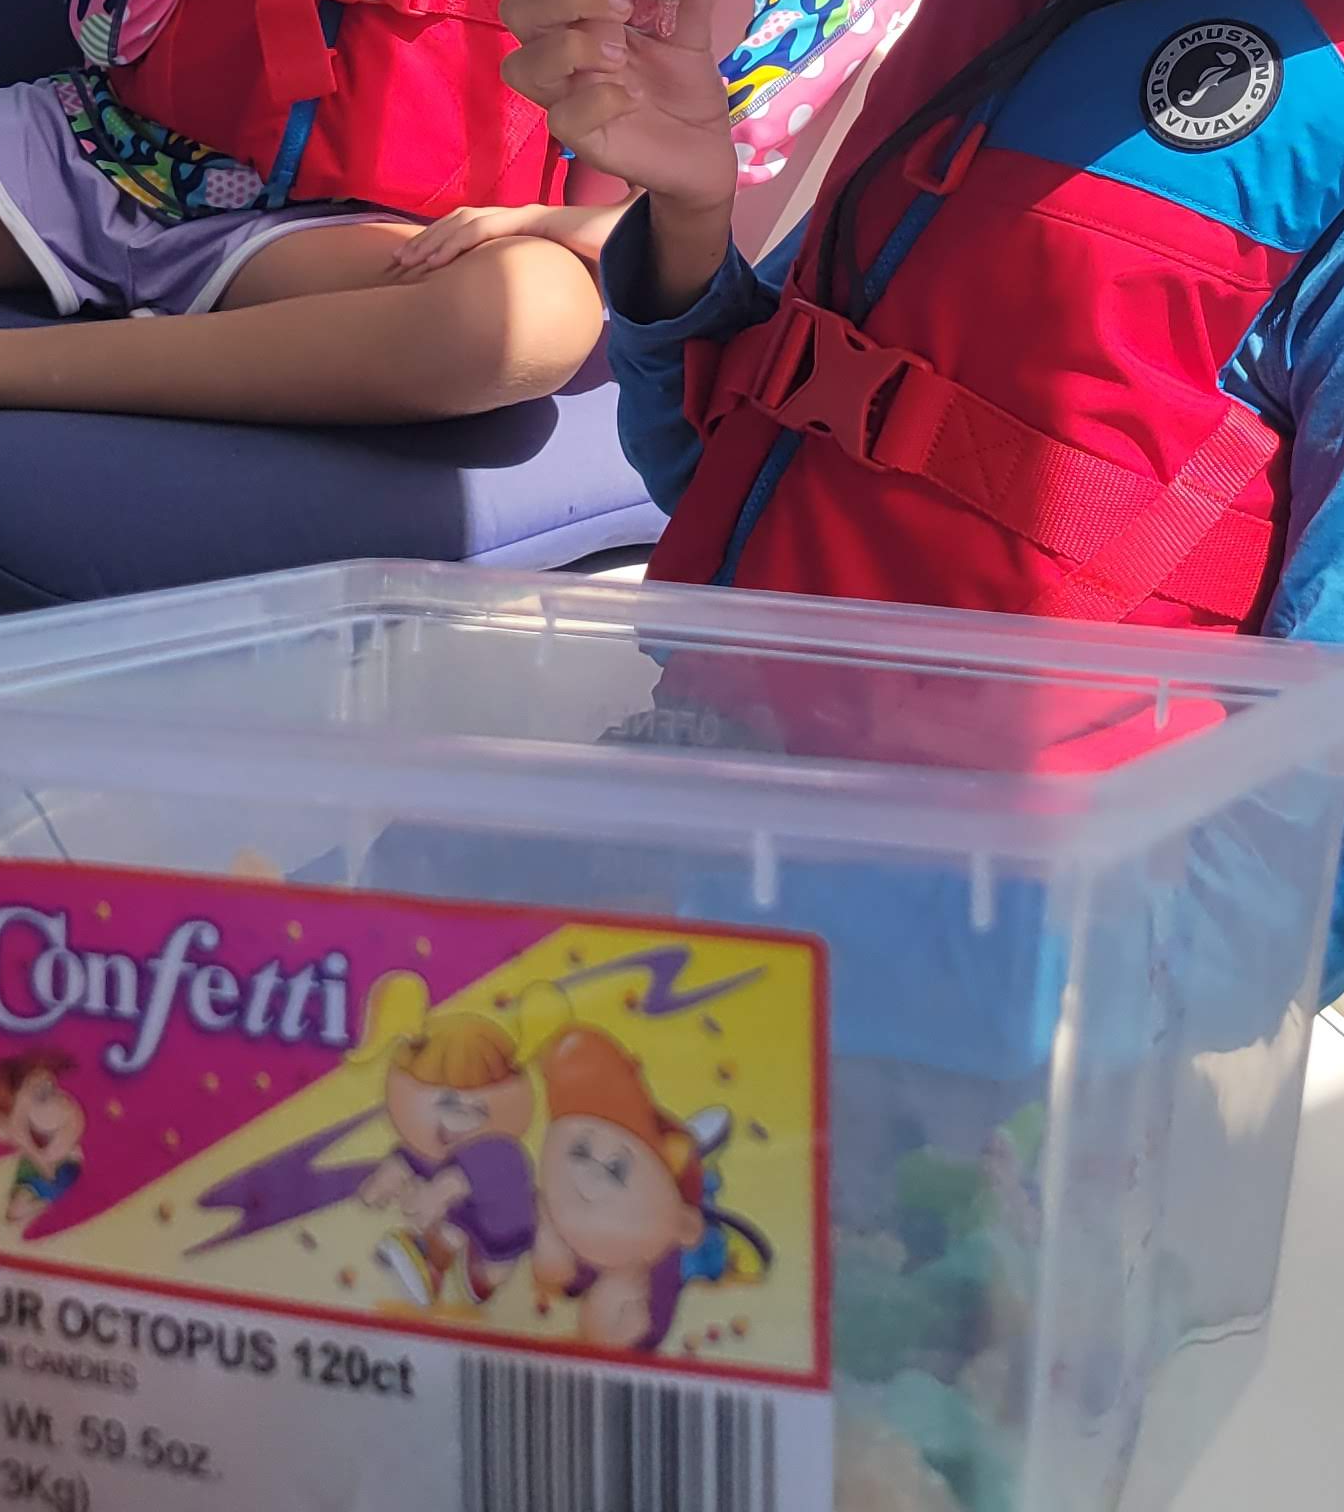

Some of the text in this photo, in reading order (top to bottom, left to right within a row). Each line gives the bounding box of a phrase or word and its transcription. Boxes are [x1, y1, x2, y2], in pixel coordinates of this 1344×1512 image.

[1151, 60, 1246, 136] SURVIVAL
[1178, 27, 1270, 100] MUSTANG
[20, 1343, 139, 1392] CANDIES
[57, 1296, 278, 1375] OCTOPUS
[293, 1336, 416, 1399] 120ct
